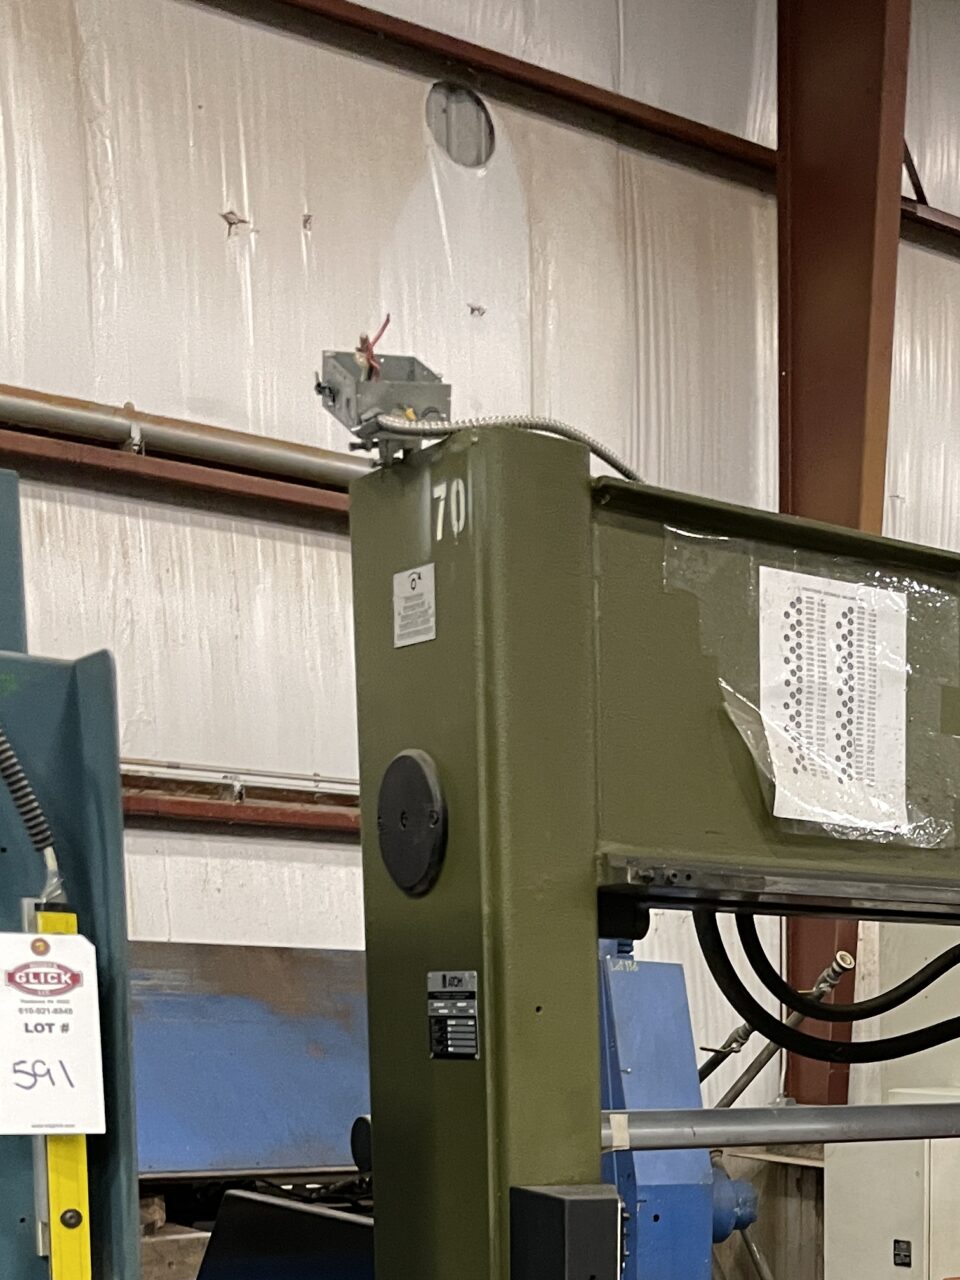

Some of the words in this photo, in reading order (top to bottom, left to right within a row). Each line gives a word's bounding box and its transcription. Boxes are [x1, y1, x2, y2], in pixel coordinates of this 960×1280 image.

[433, 478, 466, 541] 70
[15, 972, 72, 985] GLICK
[24, 1022, 56, 1034] LOT
[60, 1022, 70, 1034] #
[12, 1059, 75, 1090] 591
